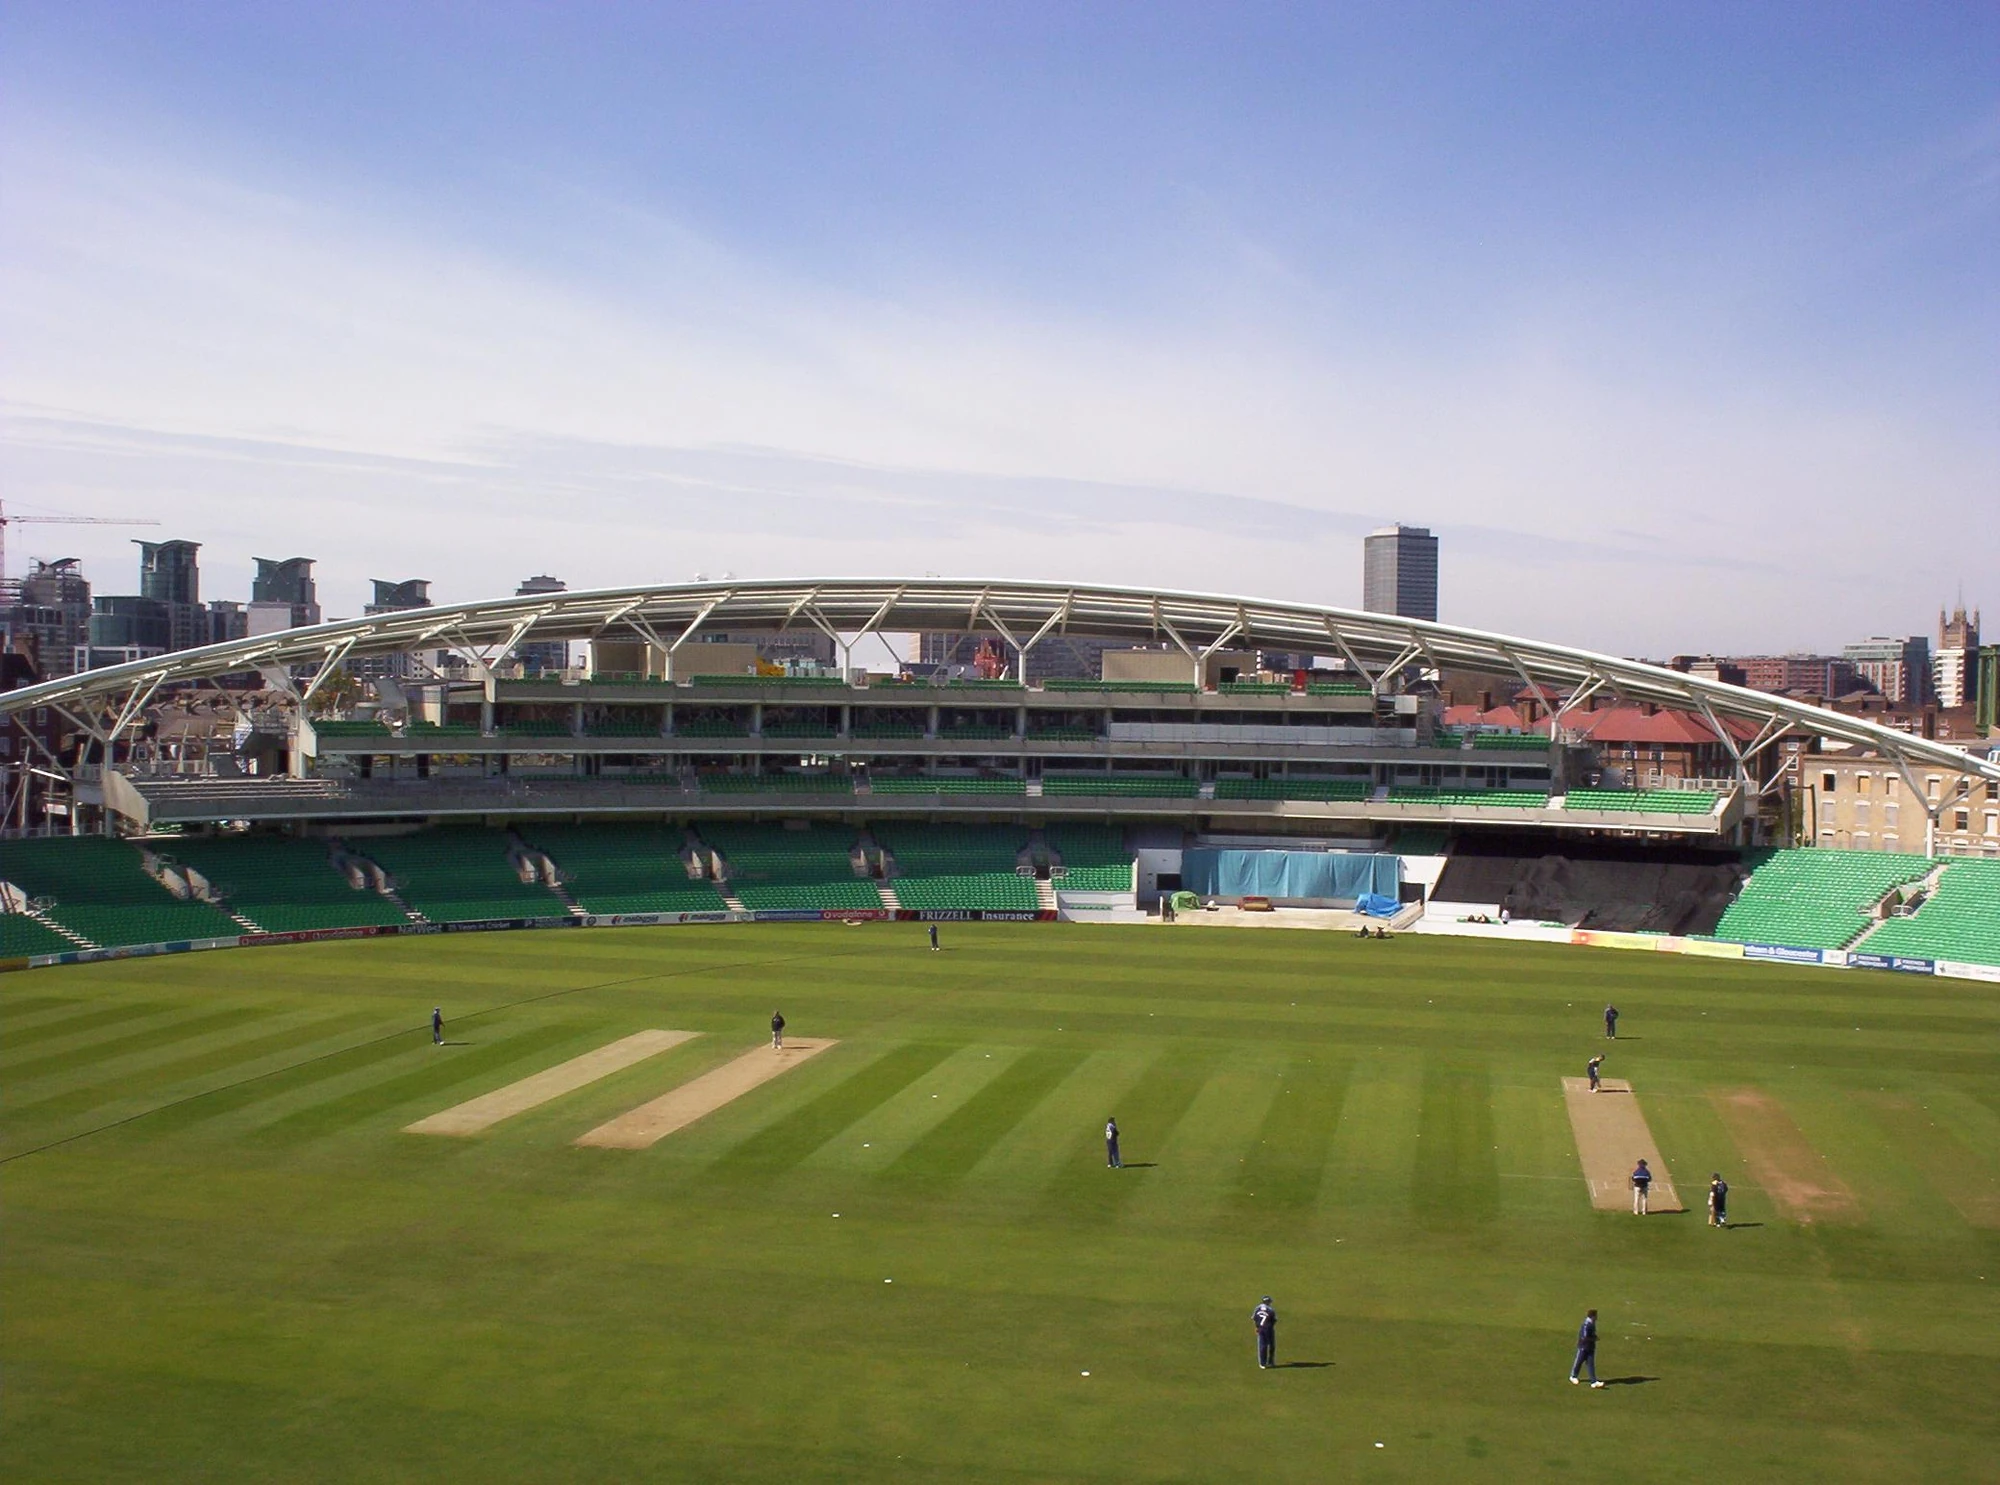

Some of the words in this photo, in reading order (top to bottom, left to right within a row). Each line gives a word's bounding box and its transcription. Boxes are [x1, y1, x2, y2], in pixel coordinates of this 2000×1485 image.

[919, 911, 972, 920] FRIZZELL
[982, 911, 1034, 920] Insurance
[398, 924, 442, 935] NatWest
[1259, 1314, 1267, 1326] 7
